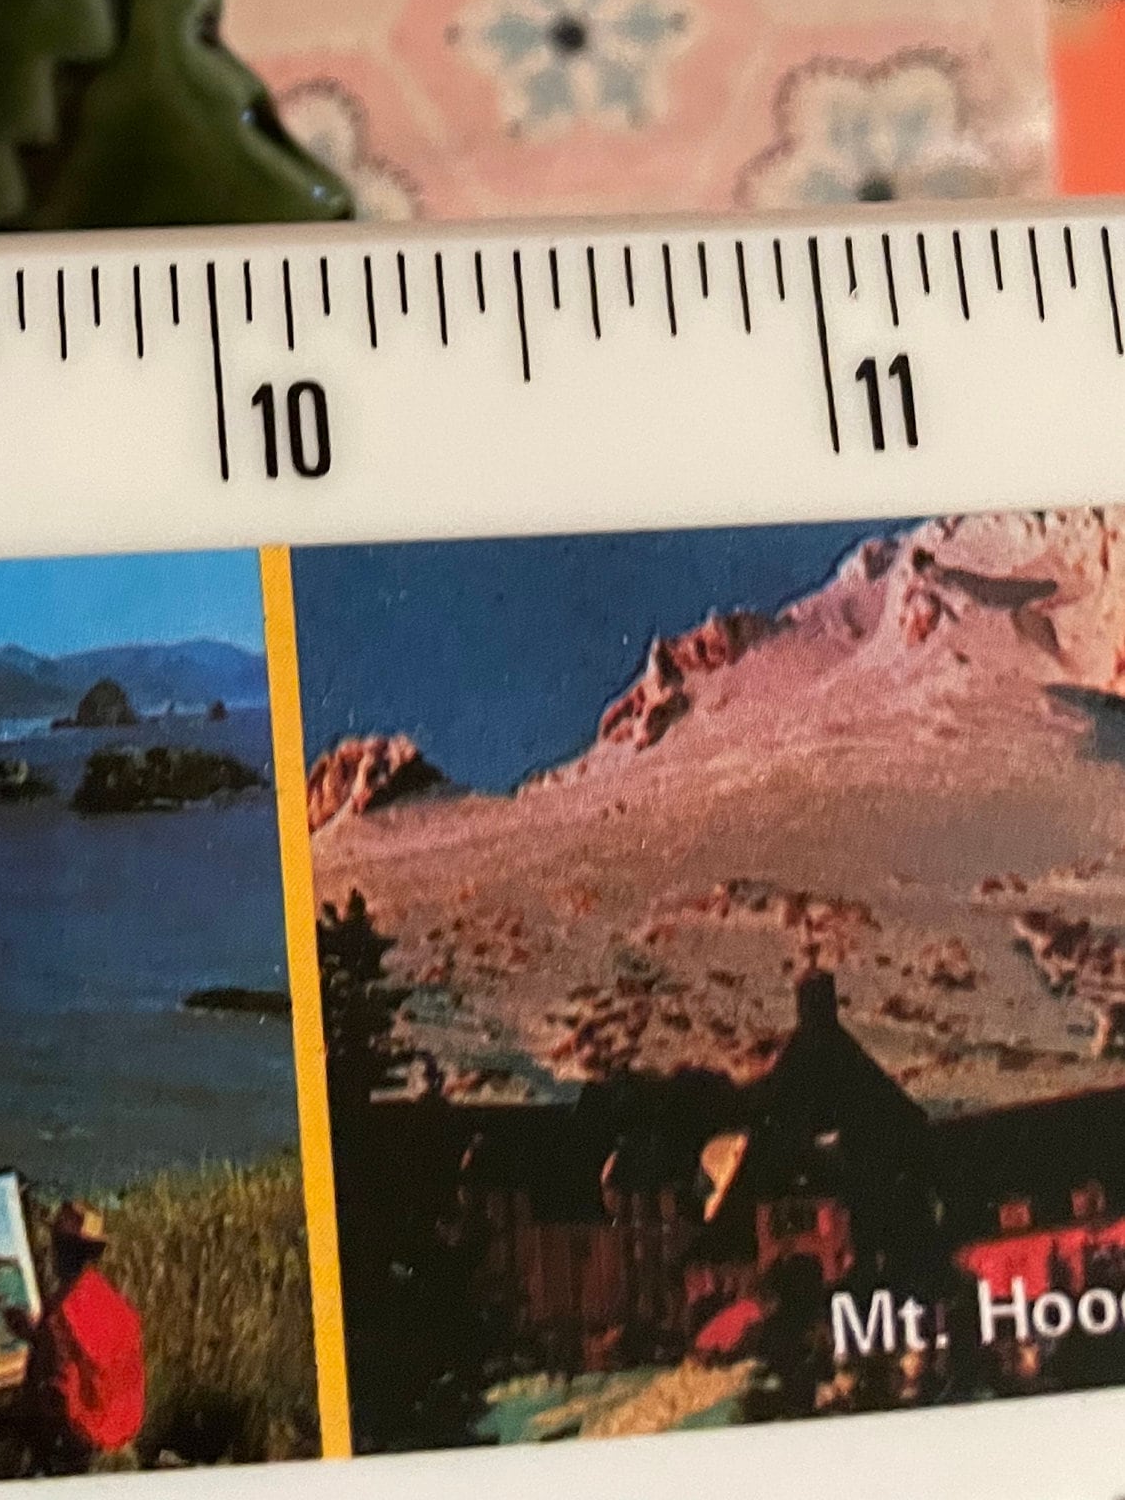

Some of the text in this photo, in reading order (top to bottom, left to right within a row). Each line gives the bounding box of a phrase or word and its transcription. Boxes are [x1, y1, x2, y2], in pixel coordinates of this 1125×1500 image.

[251, 379, 332, 480] 10
[855, 353, 919, 452] 11
[831, 1275, 1125, 1358] Mt. Hoo
